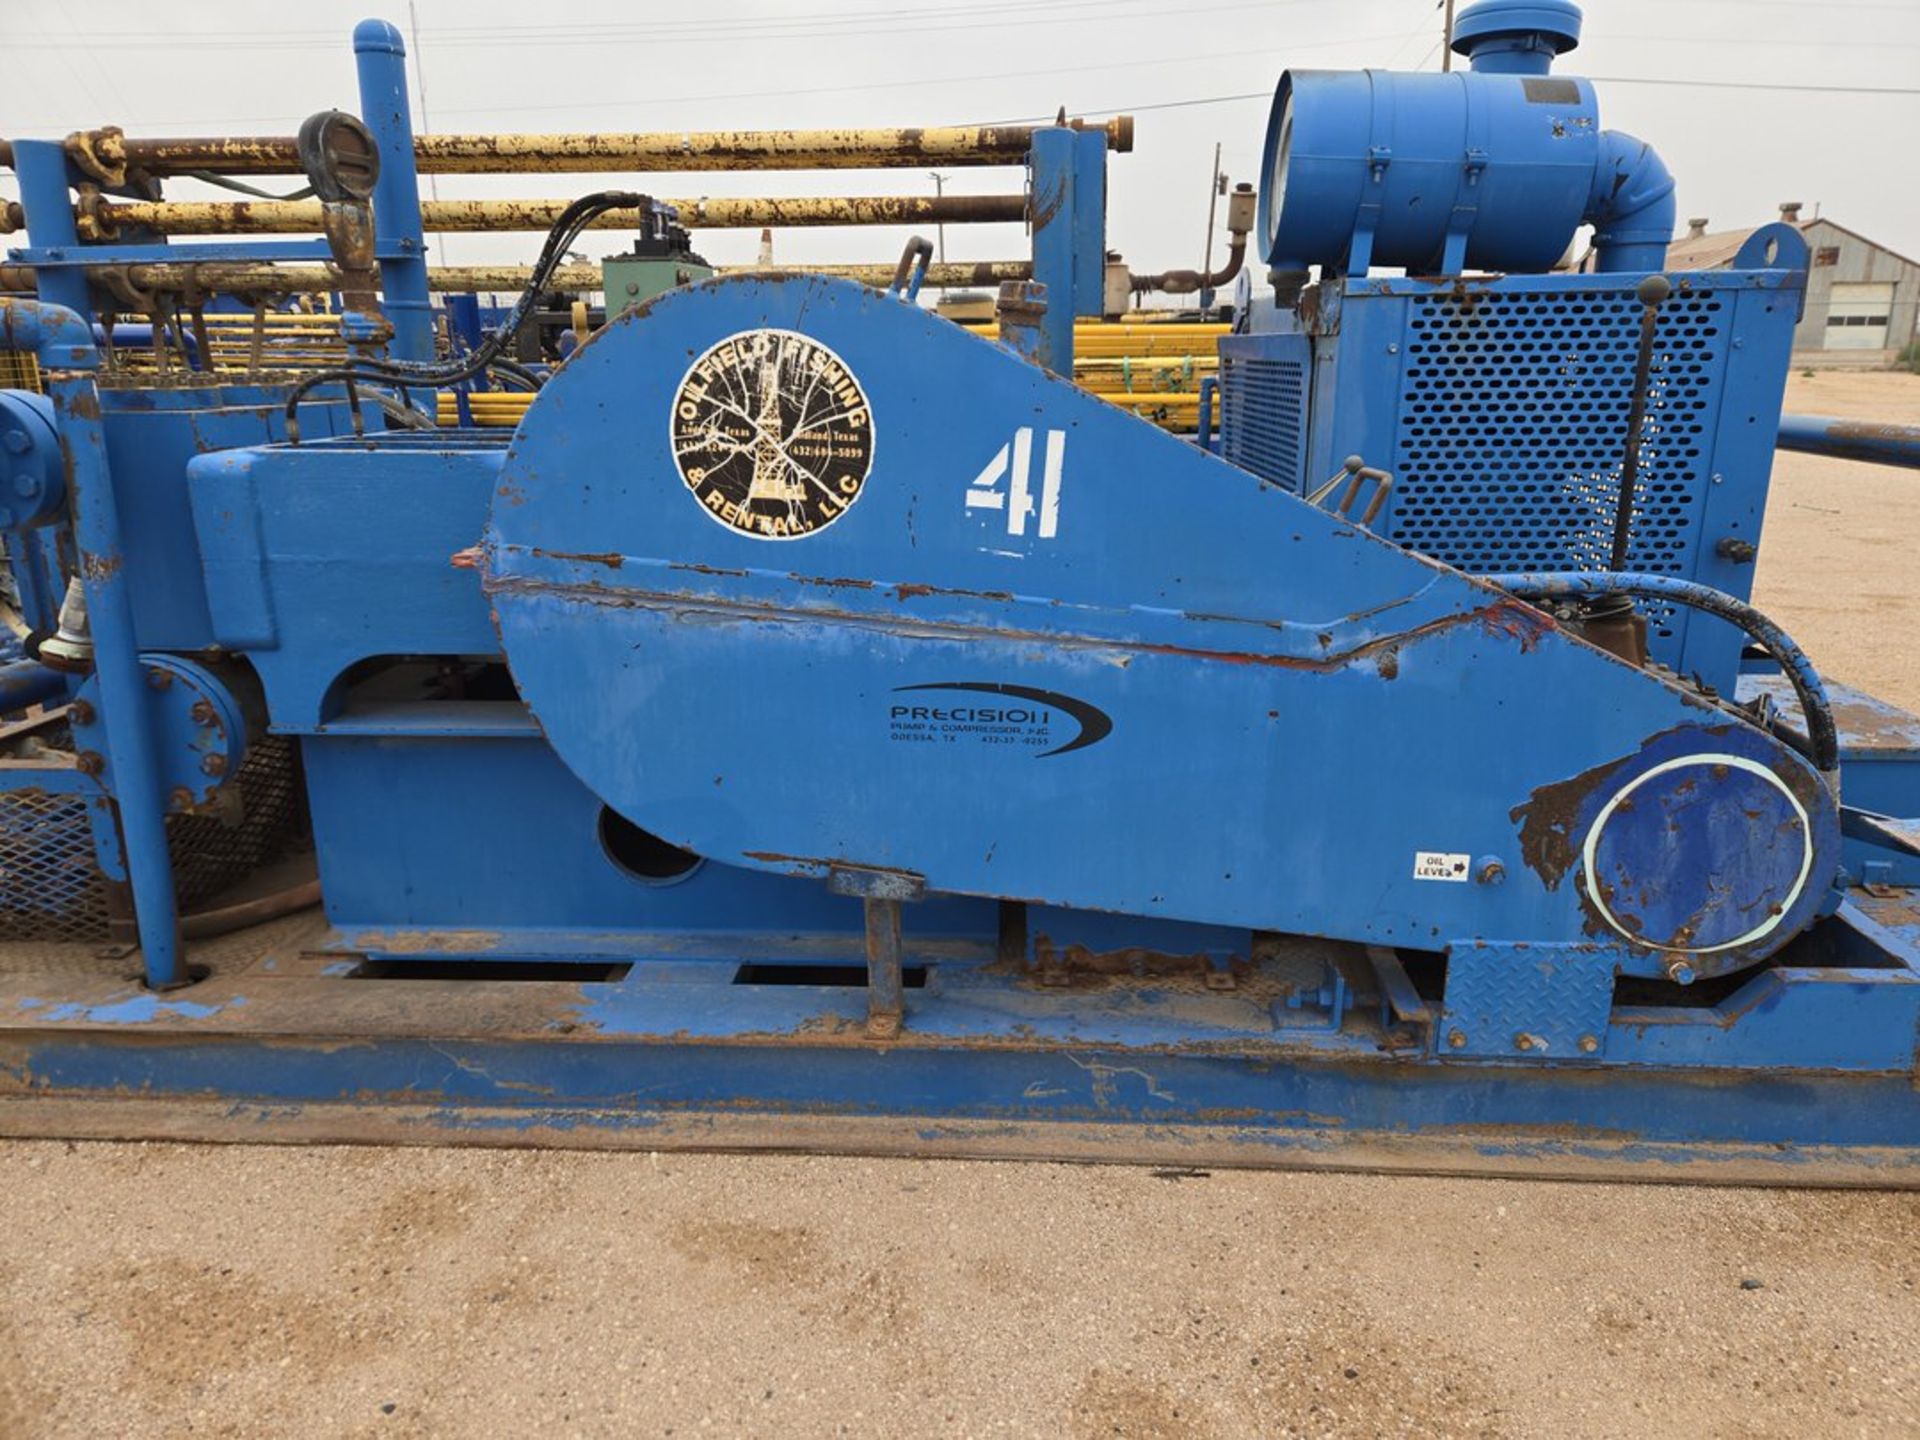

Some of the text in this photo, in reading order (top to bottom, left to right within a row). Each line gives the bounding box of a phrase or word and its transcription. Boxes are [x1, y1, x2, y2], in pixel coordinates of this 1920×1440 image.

[678, 333, 867, 428] OILFIELD FISHING
[833, 431, 859, 442] Texas
[965, 426, 1066, 538] 41
[818, 474, 858, 520] LLC
[891, 723, 926, 731] PUMP
[928, 722, 938, 732] &
[943, 734, 957, 743] TX
[1427, 857, 1444, 866] OIL
